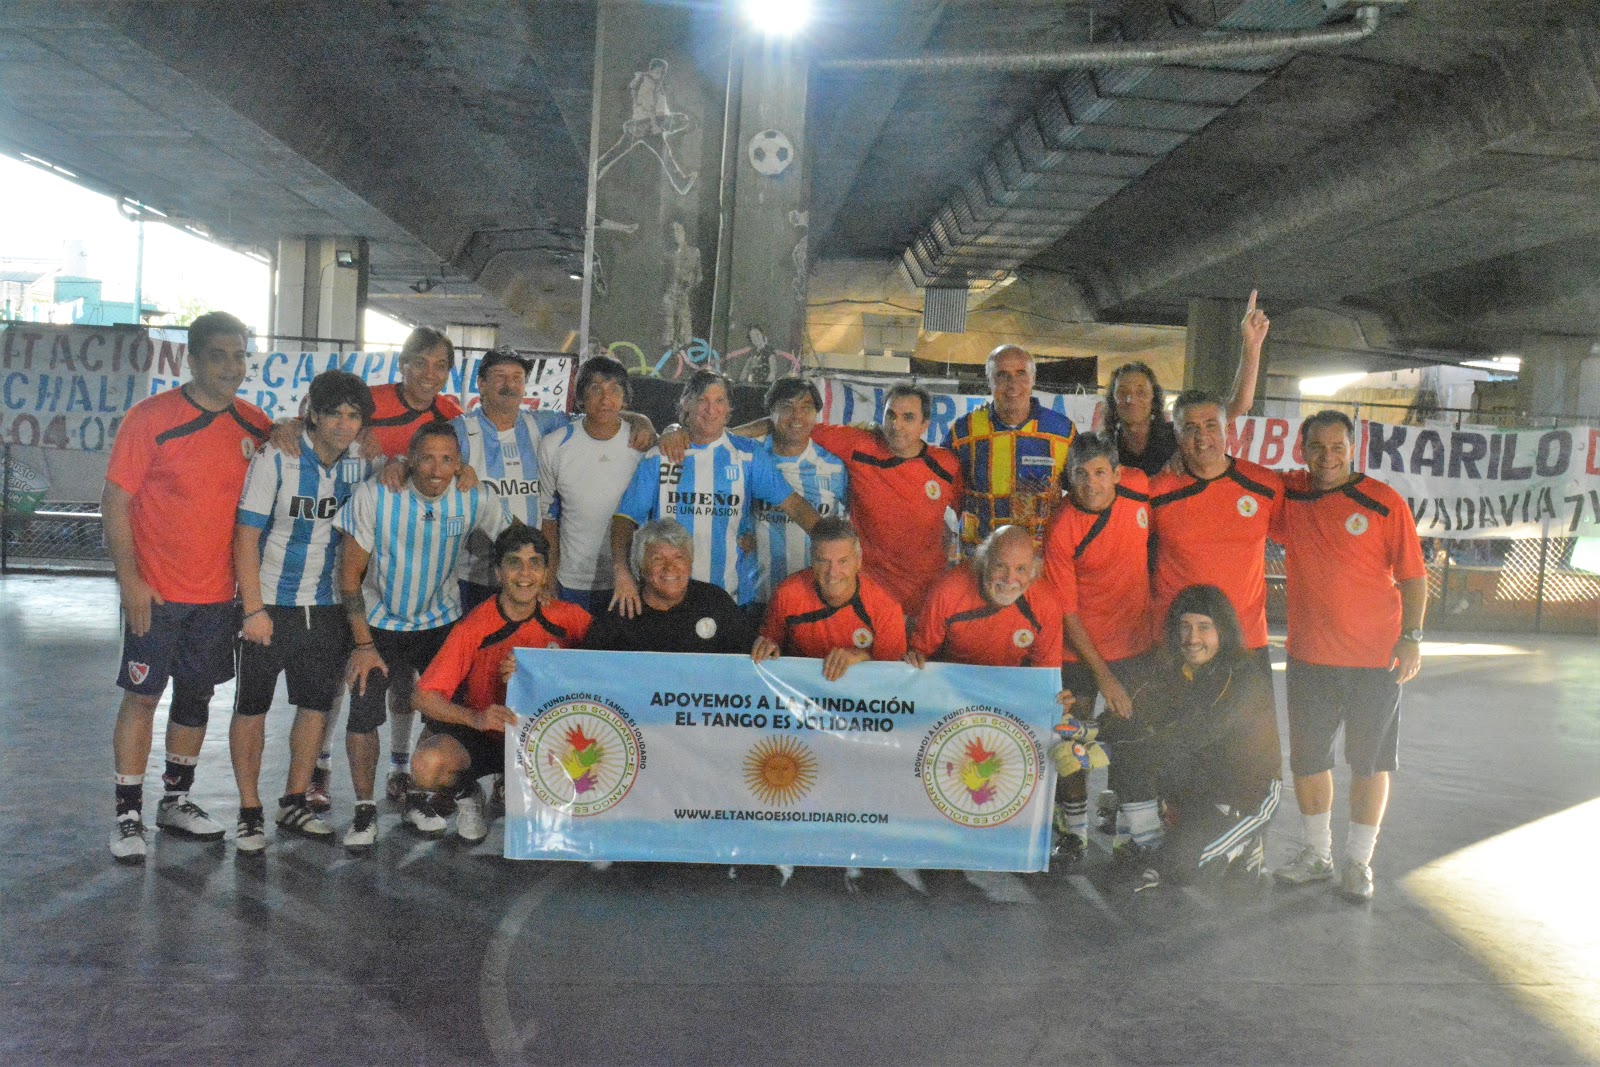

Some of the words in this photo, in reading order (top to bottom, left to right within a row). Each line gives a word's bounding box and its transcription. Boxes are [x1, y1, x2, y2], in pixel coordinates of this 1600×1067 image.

[553, 380, 563, 396] 6
[1368, 422, 1573, 481] KARILO
[668, 490, 740, 507] DUEÑO
[666, 506, 677, 514] DE
[680, 506, 702, 515] UNA
[650, 691, 753, 709] APOYEMOS
[757, 696, 770, 710] A
[534, 707, 568, 733] TANGO
[572, 704, 588, 712] ES
[591, 706, 636, 756] SOLIDARIO
[534, 708, 544, 718] LA
[543, 691, 592, 709] FUNDACIÓN
[594, 694, 602, 703] EL
[605, 698, 629, 719] TANGO
[628, 718, 637, 728] ES
[633, 728, 647, 770] SOLIDARIO
[675, 711, 696, 726] EL
[702, 712, 767, 728] TANGO
[773, 714, 791, 729] ES
[796, 715, 894, 733] SOLIDARIO
[914, 735, 931, 778] APOYEMOS
[933, 721, 944, 732] LA
[943, 704, 992, 722] FUNDACIÓN
[993, 707, 1003, 715] EL
[1005, 711, 1030, 731] TANGO
[1028, 730, 1037, 740] ES
[1033, 739, 1046, 781] SOLIDARIO
[932, 719, 969, 746] TANGO
[972, 716, 988, 724] ES
[991, 718, 1035, 766] SOLIDARIO
[674, 808, 889, 824] WWW.ELTANGOESSOLIDIARIO.COM
